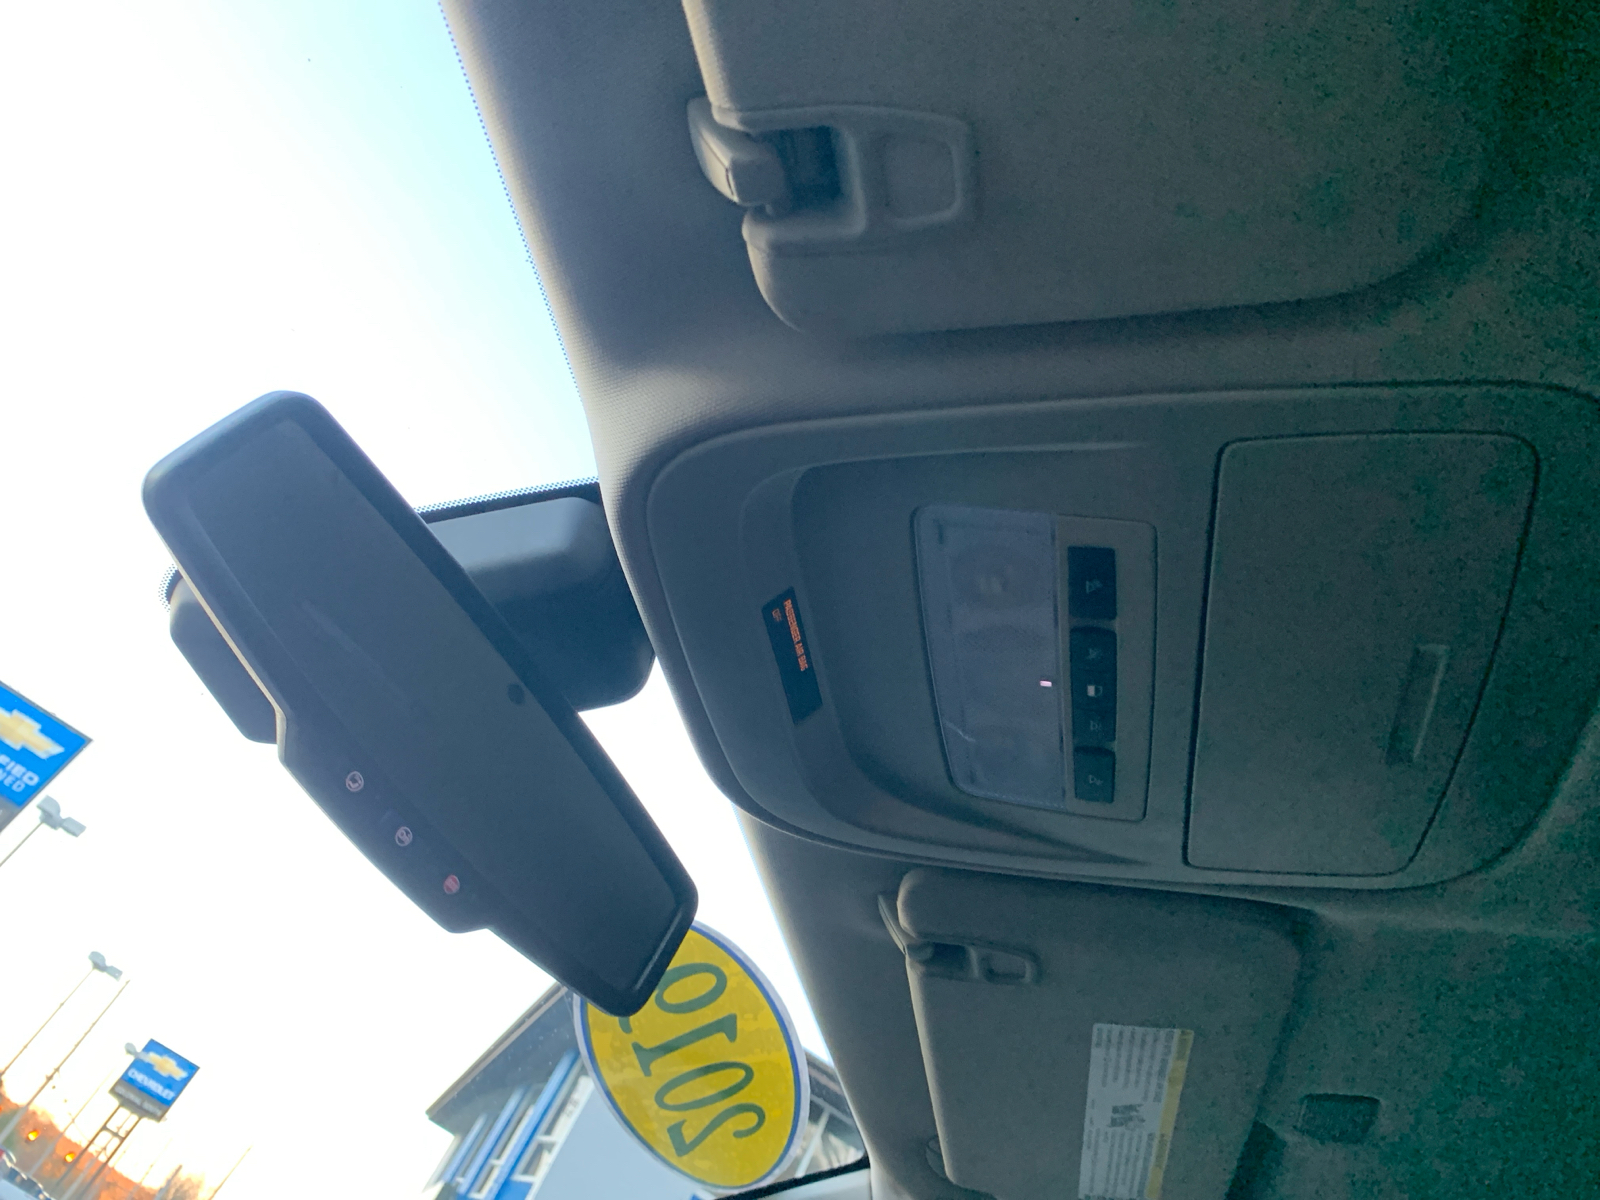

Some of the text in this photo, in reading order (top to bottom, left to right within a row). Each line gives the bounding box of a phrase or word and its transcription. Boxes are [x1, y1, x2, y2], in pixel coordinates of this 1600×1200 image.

[784, 599, 809, 671] PASSENGER AIR BAG
[128, 1068, 175, 1101] CHEVROLET
